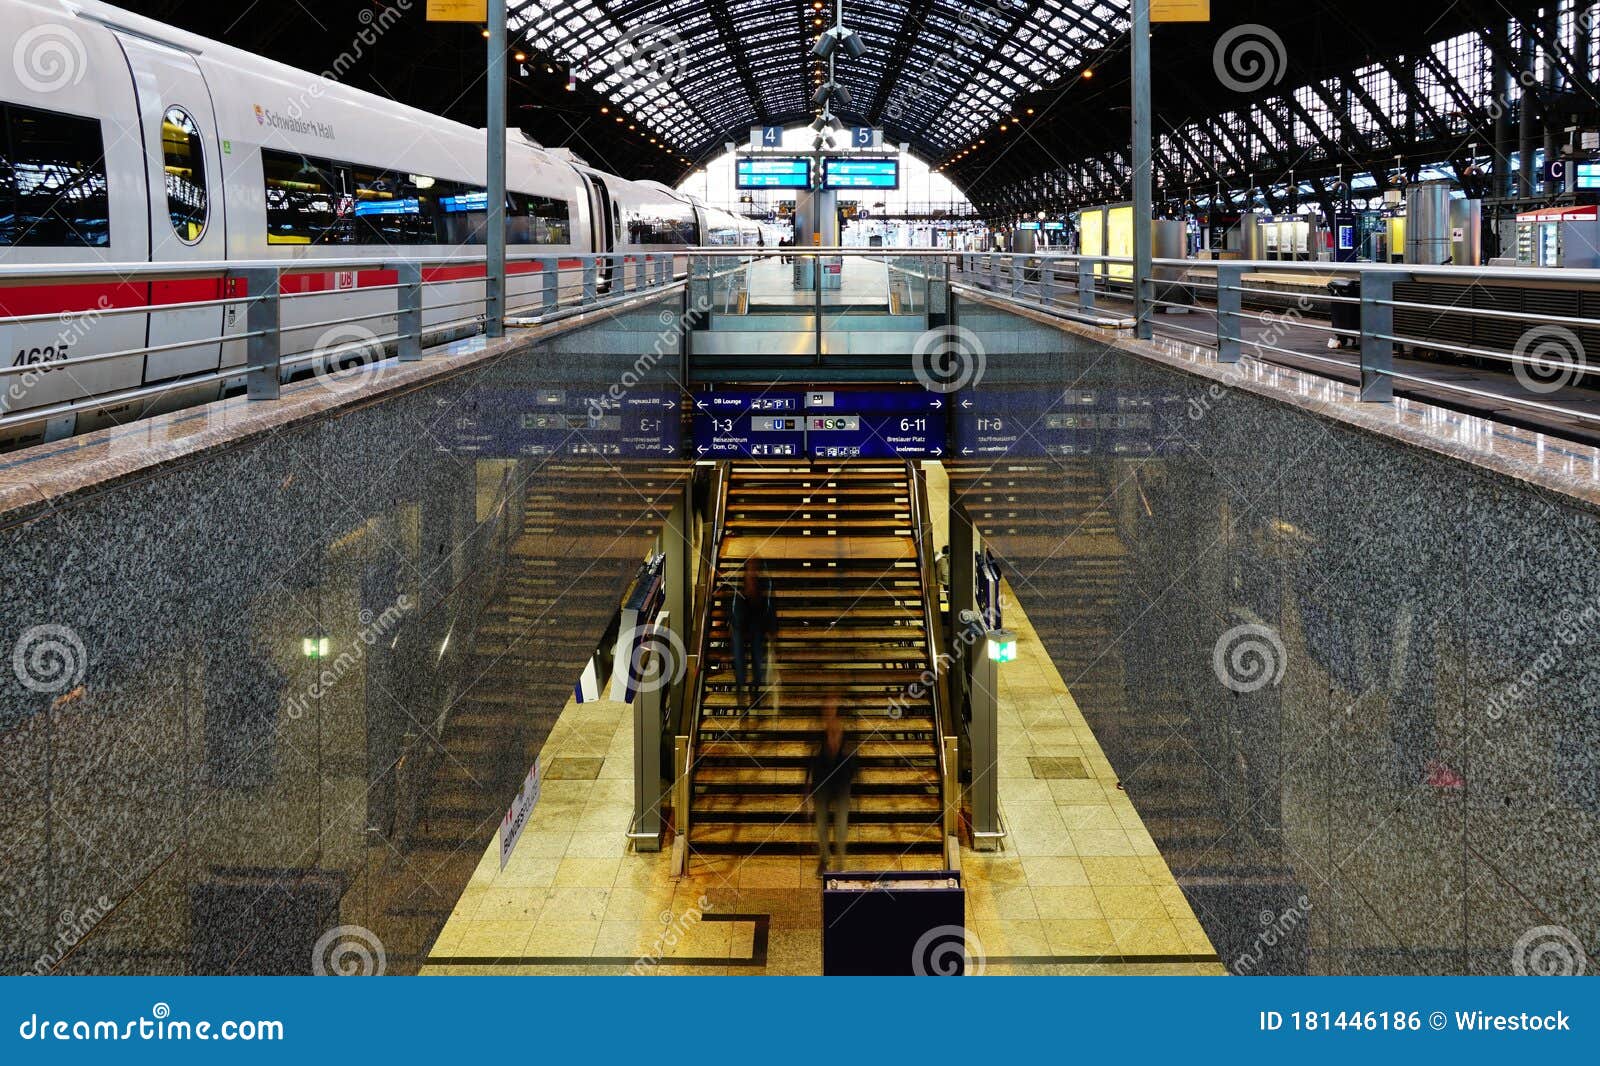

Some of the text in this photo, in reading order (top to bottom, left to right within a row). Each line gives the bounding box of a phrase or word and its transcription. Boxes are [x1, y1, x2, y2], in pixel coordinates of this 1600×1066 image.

[319, 123, 335, 140] Hall
[765, 127, 776, 143] 4
[858, 127, 869, 143] 5
[1551, 161, 1563, 178] C
[712, 418, 733, 431] 1-3
[900, 418, 926, 431] 6-11
